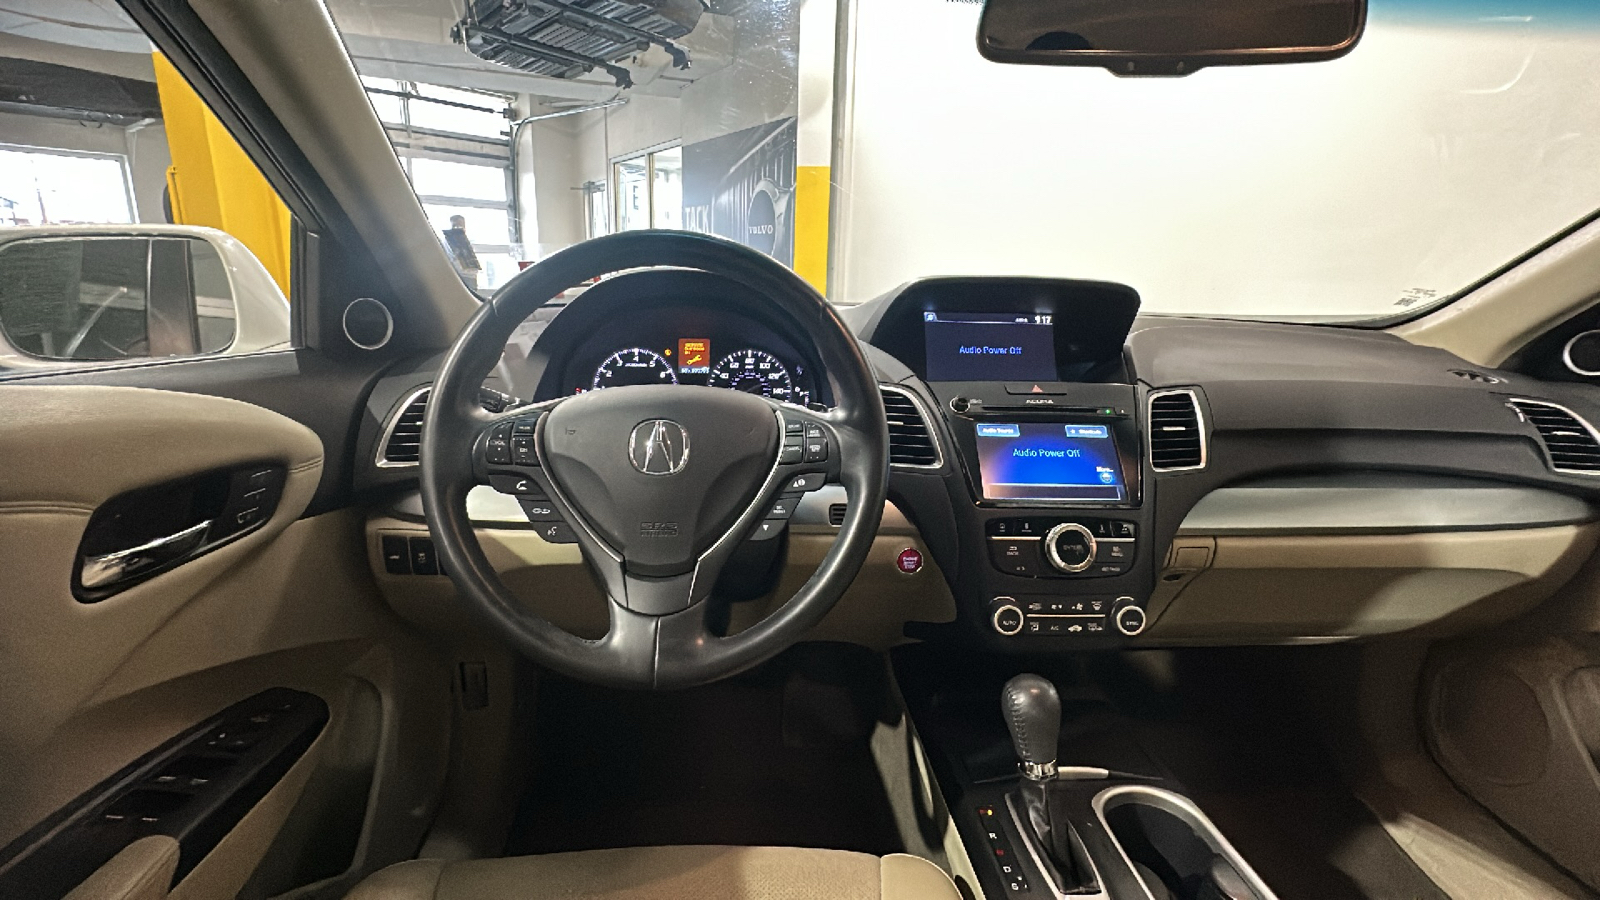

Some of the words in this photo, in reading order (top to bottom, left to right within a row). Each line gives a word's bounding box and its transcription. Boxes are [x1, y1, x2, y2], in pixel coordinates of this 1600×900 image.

[749, 225, 773, 234] VOLVO
[959, 345, 982, 354] Audio
[983, 346, 1007, 354] Power
[1009, 346, 1022, 354] Off
[1013, 448, 1037, 457] Audio
[1039, 449, 1064, 458] Power
[1067, 449, 1081, 458] Off
